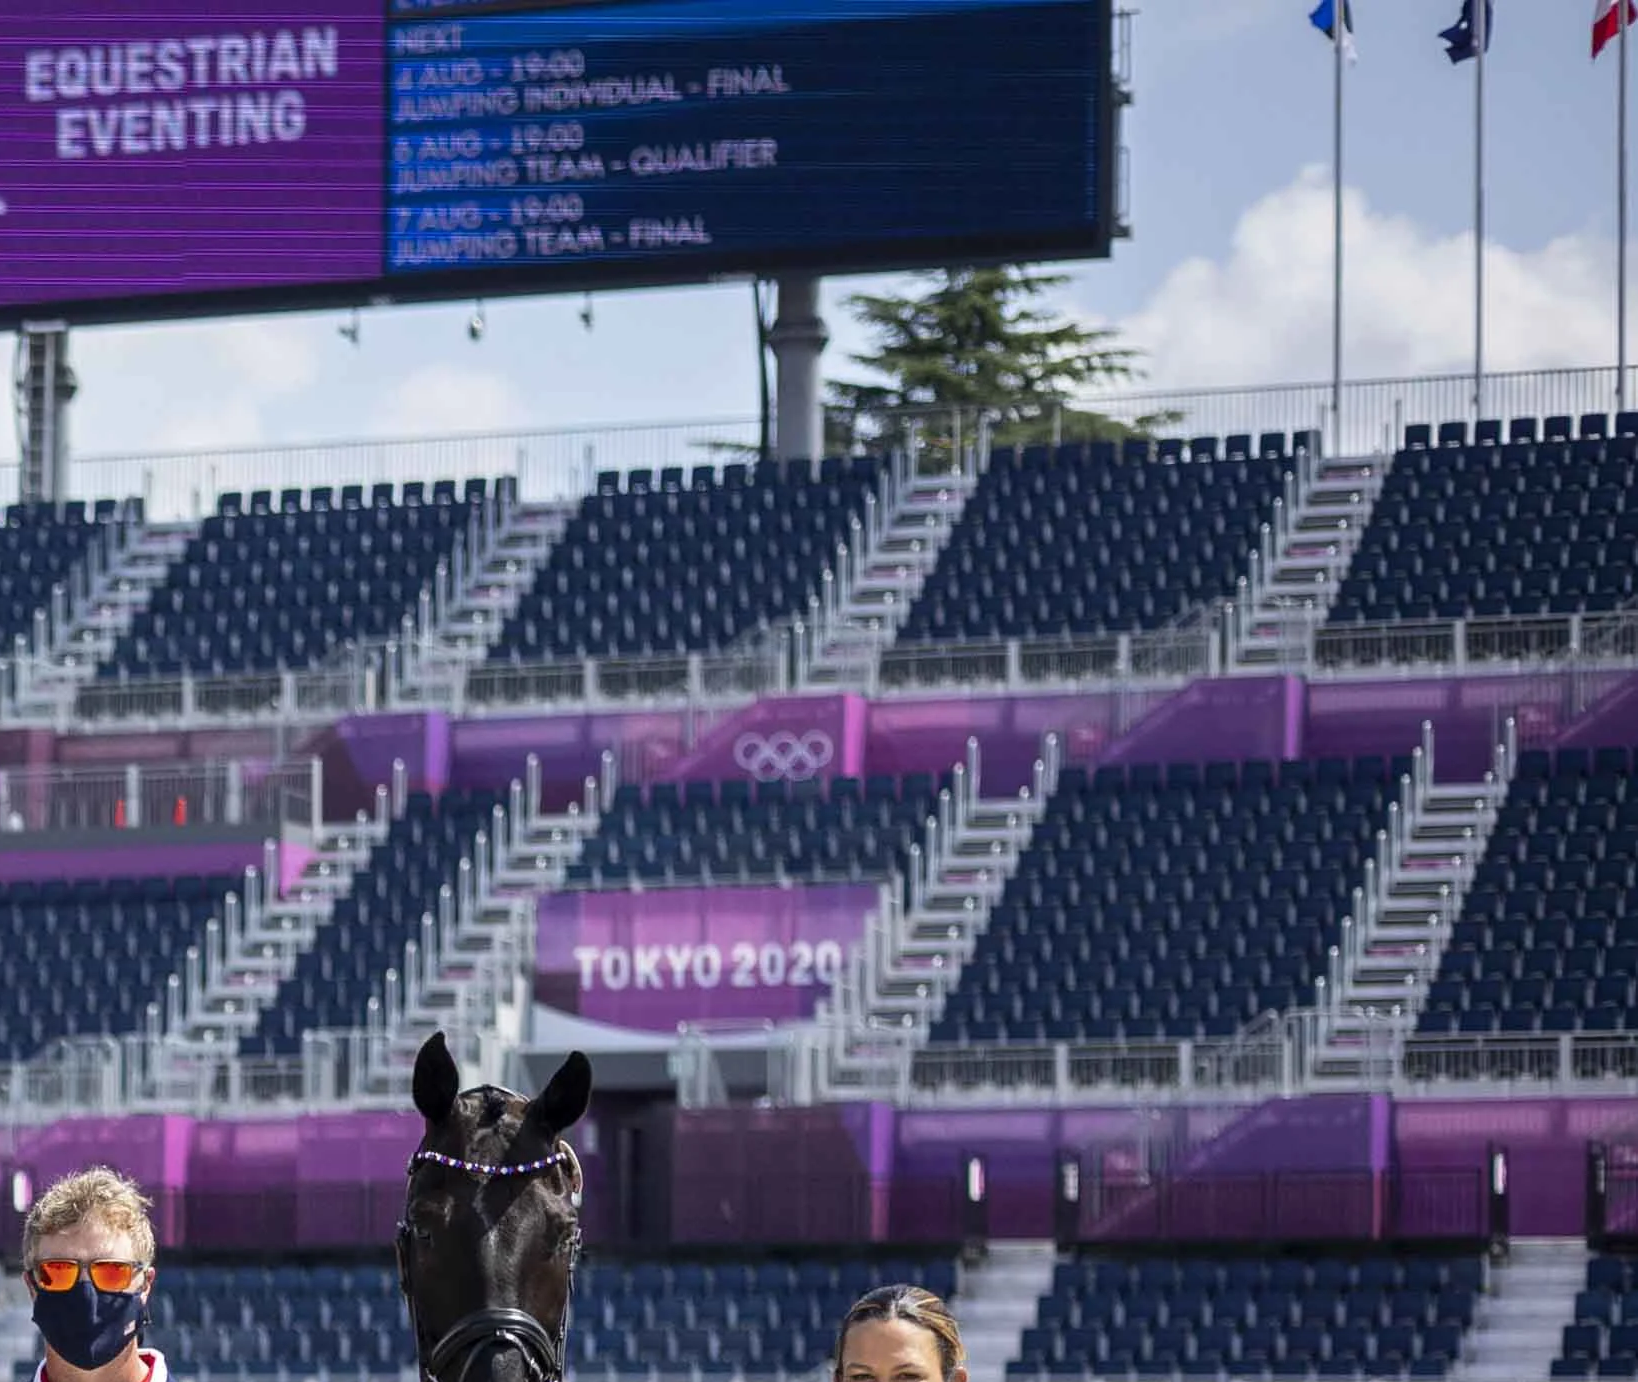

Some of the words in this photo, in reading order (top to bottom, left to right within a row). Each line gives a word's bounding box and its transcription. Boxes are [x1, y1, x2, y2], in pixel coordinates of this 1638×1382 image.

[25, 27, 339, 101] EQUESTRIAN
[395, 24, 464, 55] NEXT
[395, 87, 520, 122] JUMPING
[525, 72, 683, 114] INDIVIDUAL
[707, 65, 790, 98] FINAL
[419, 58, 483, 89] AUG
[510, 48, 585, 83] 19:00
[56, 90, 307, 159] EVENTING
[418, 129, 483, 161] AUG
[510, 121, 585, 155] 19:00
[395, 158, 519, 194] JUMPING
[523, 154, 606, 183] TEAM
[628, 139, 778, 175] QUALIFIER
[419, 200, 483, 230] AUG
[510, 193, 584, 225] 19:00
[395, 229, 519, 266] JUMPING
[523, 222, 605, 255] TEAM
[628, 214, 713, 246] FINAL
[574, 943, 722, 991] TOKYO
[731, 940, 842, 987] 2020
